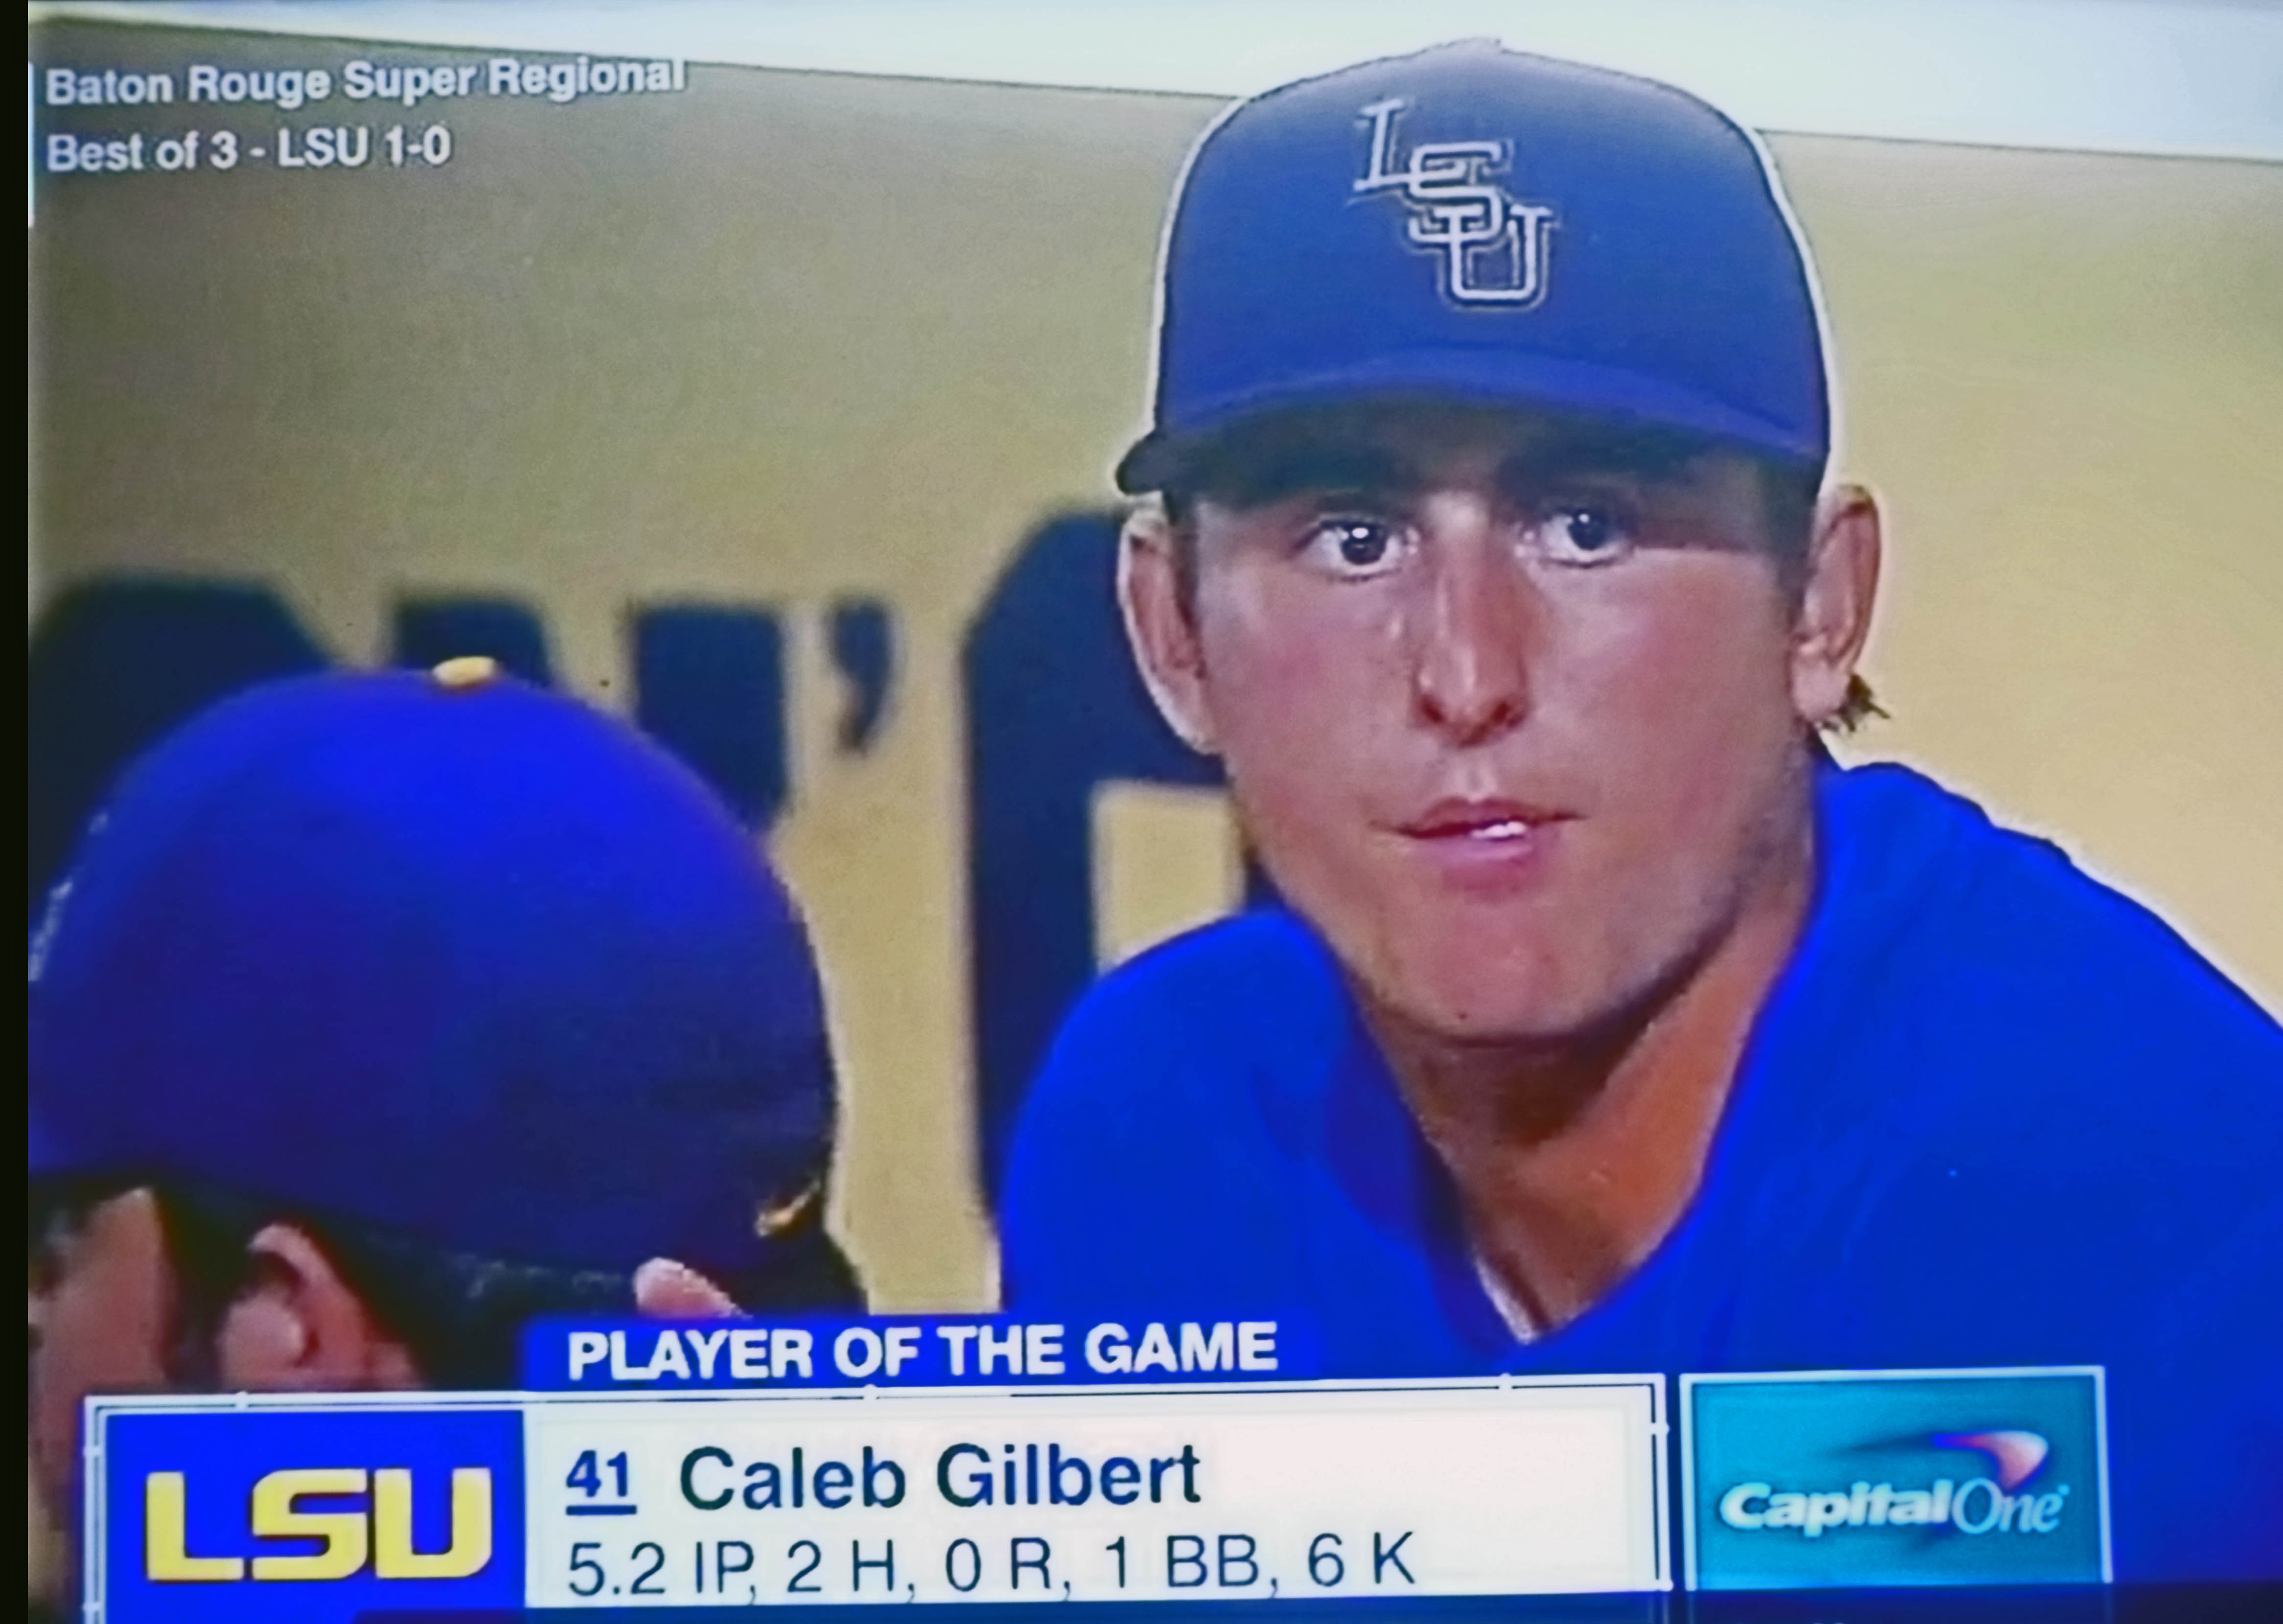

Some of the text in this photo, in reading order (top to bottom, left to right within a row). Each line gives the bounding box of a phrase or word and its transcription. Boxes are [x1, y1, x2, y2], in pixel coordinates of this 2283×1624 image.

[47, 56, 684, 109] Baton Rouge Super Regional
[47, 124, 451, 171] Best of 3 - LSU 1-0
[1354, 98, 1556, 311] LSU
[568, 1322, 1278, 1380] PLAYER OF THE GAME
[566, 1442, 1201, 1510] 41 Caleb Gilbert
[145, 1466, 492, 1581] LSU
[568, 1530, 1417, 1605] 5.2 IP, 2 H, 0 R, 1 BB, 6 K
